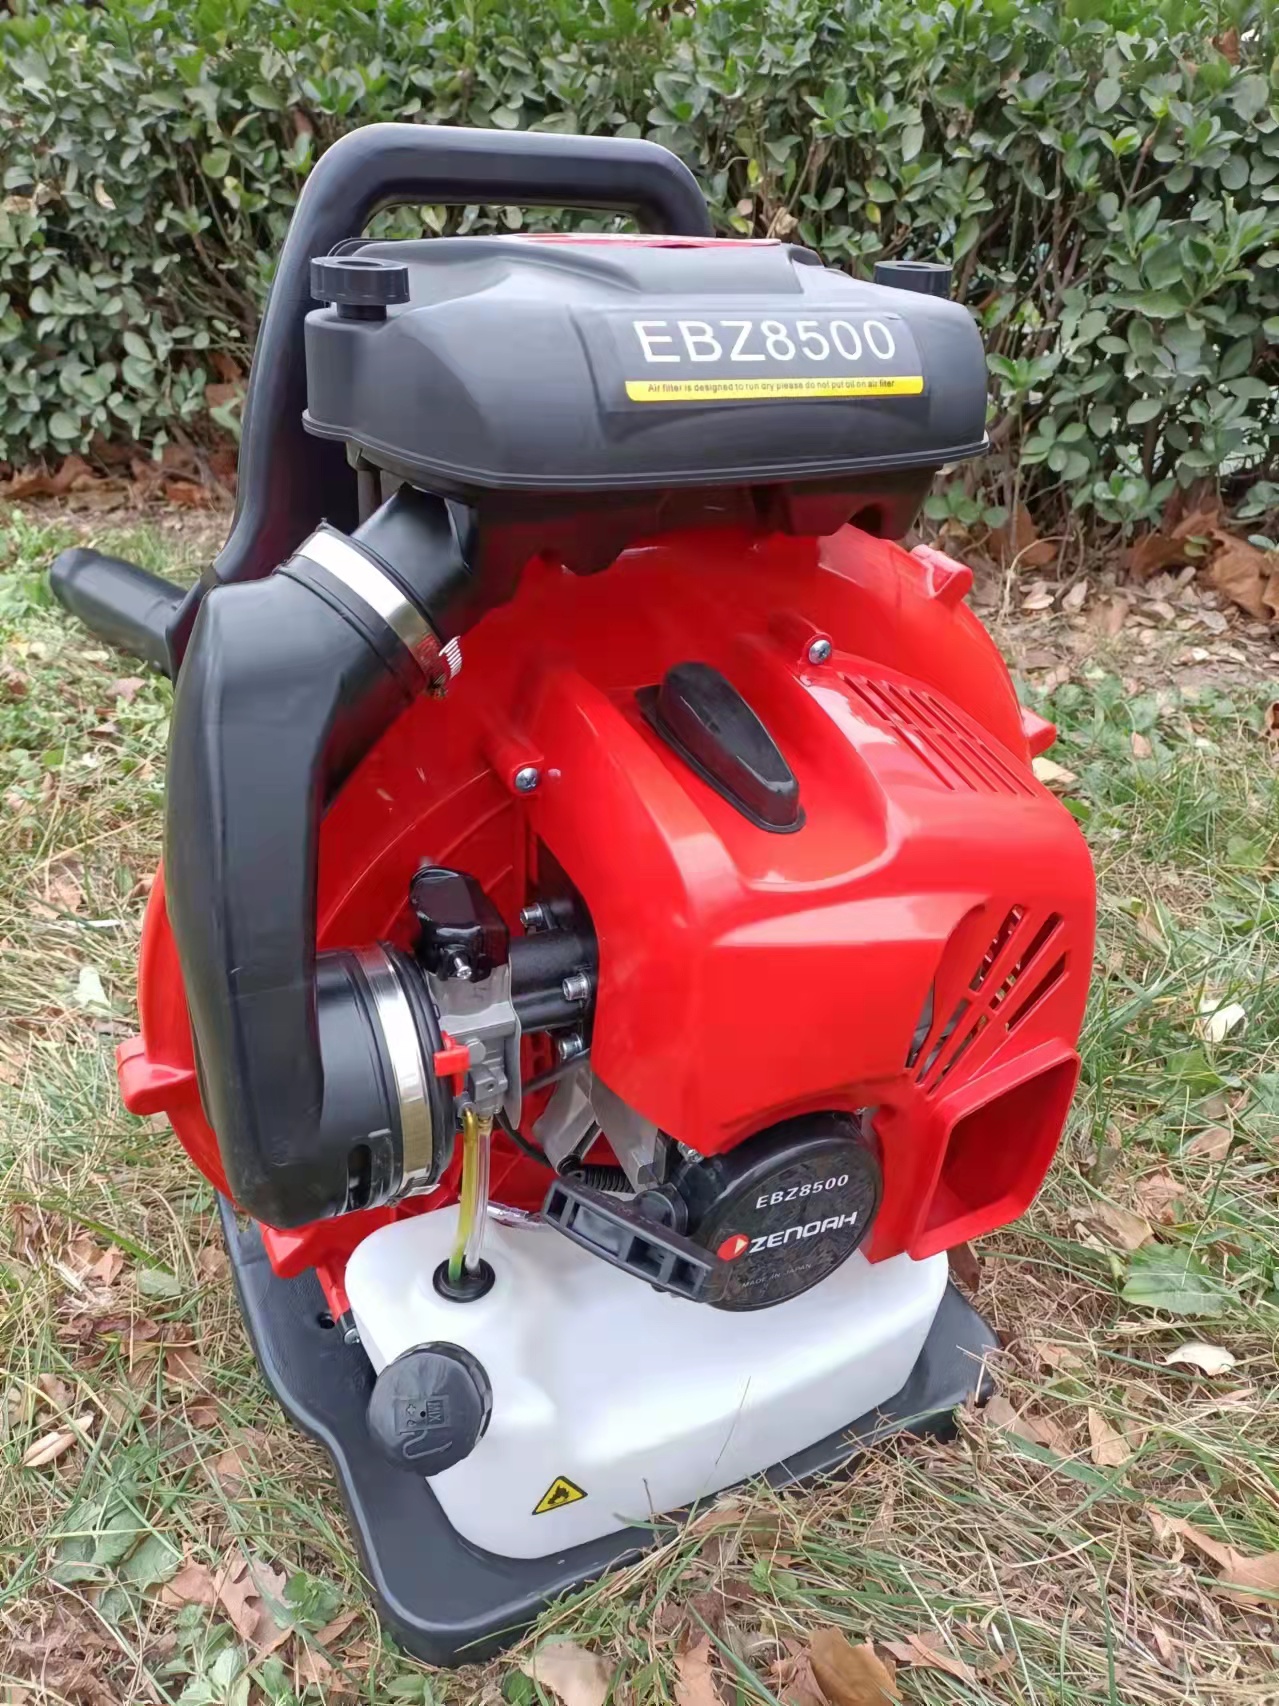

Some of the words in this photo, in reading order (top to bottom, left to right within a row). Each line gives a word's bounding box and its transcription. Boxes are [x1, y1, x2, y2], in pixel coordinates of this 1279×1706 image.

[633, 320, 896, 362] EBZ8500
[648, 384, 660, 392] Air
[685, 384, 692, 392] is
[694, 383, 734, 393] designed
[735, 383, 744, 391] to
[745, 383, 760, 391] run
[776, 381, 804, 391] please
[805, 381, 815, 389] do
[817, 381, 830, 389] not
[832, 380, 845, 389] put
[846, 380, 855, 389] oil
[856, 380, 866, 388] on
[755, 1174, 849, 1208] EBZ8500
[748, 1211, 858, 1254] ZENOAH
[742, 1276, 767, 1287] MADE
[786, 1263, 812, 1274] JAPAN
